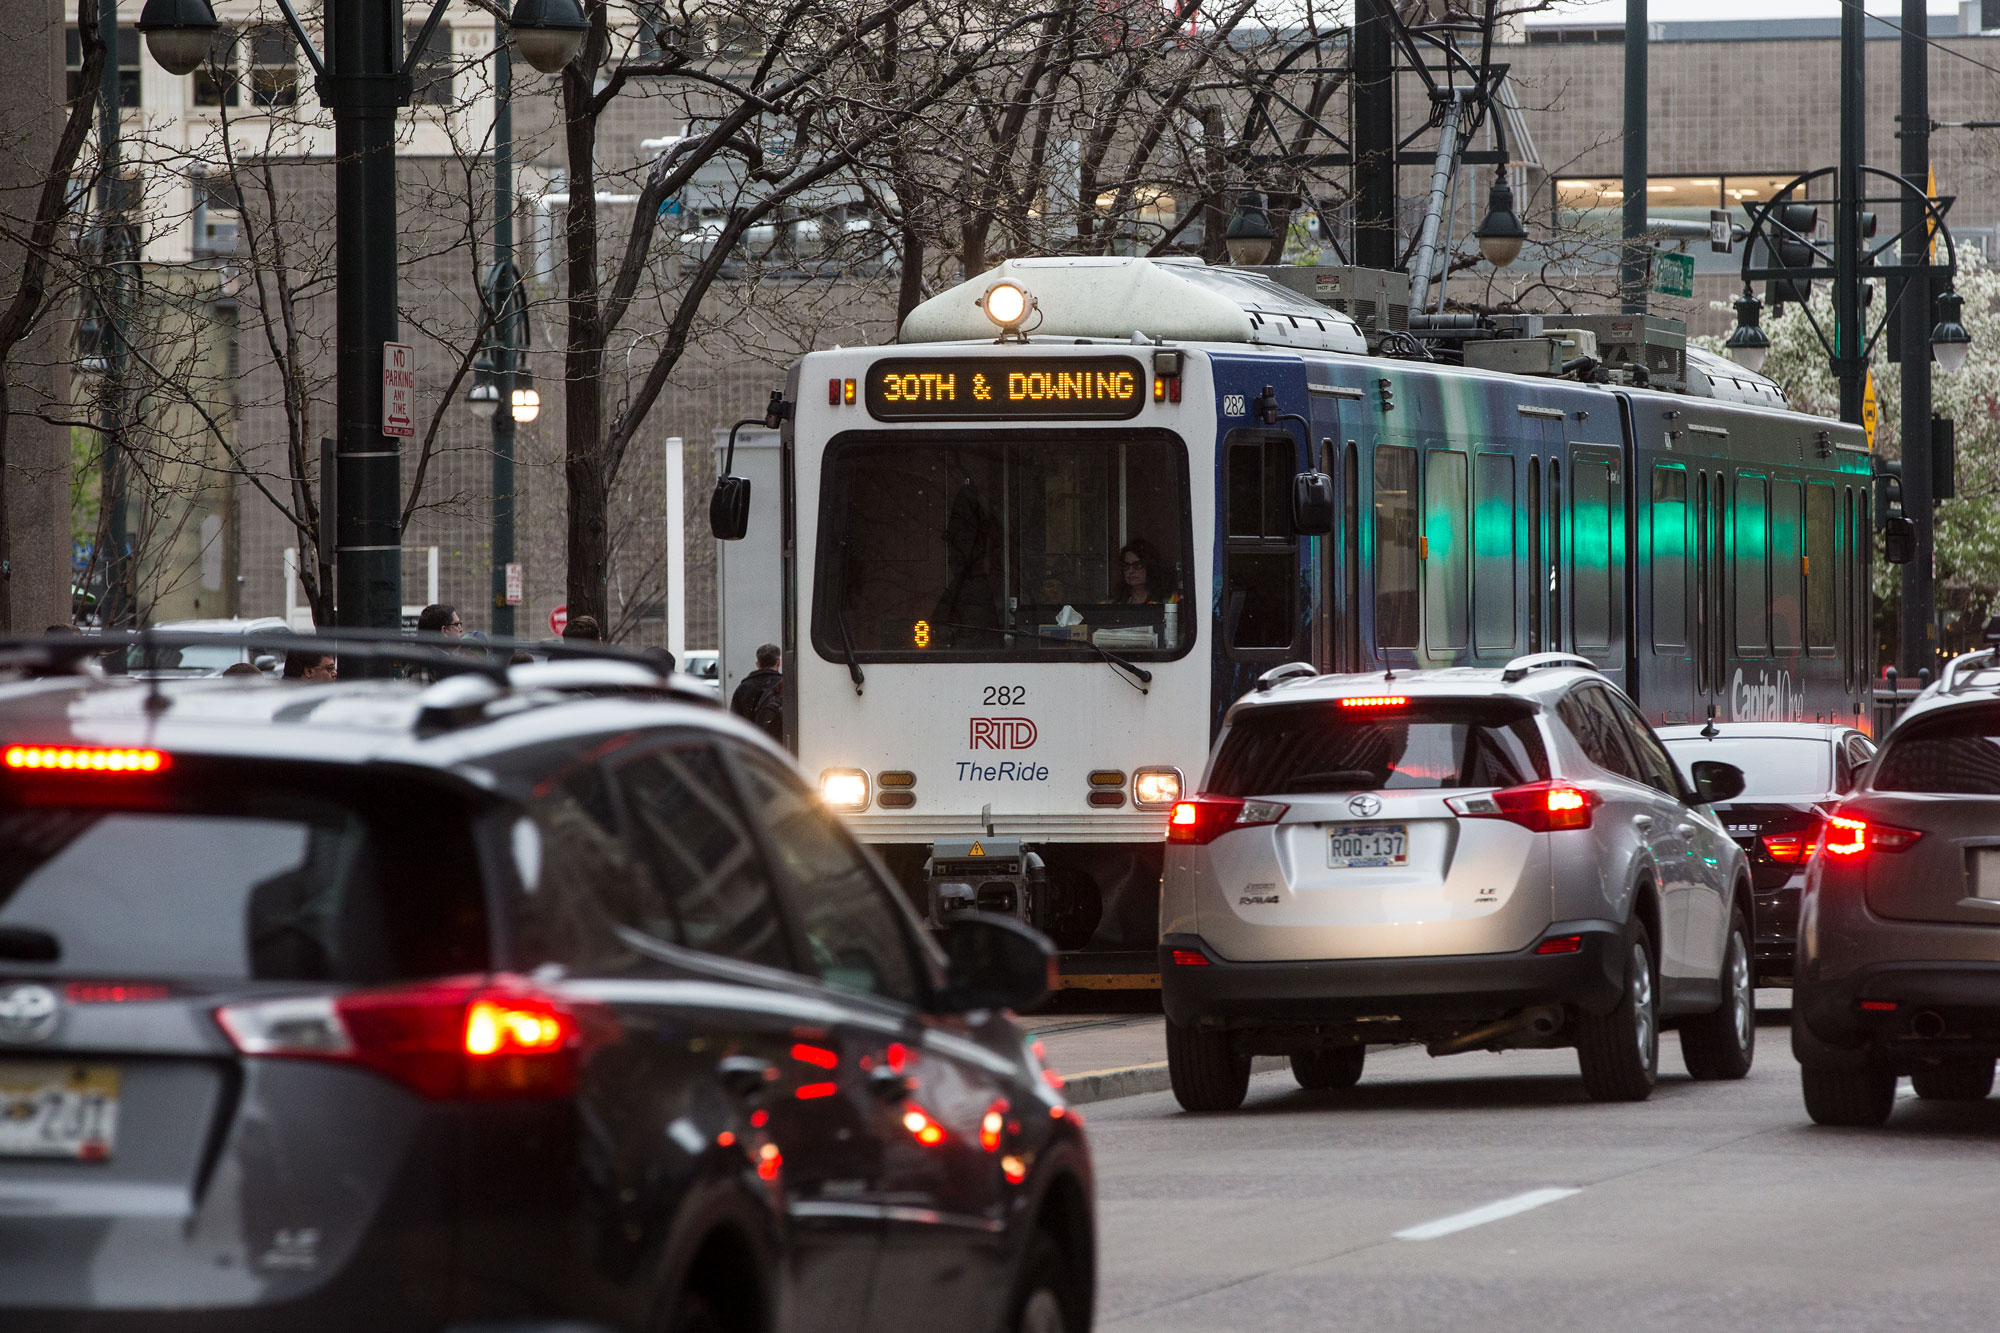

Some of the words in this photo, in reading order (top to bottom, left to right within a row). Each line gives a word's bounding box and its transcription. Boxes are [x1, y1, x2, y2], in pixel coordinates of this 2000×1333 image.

[393, 349, 406, 369] NO
[385, 369, 413, 389] PARKING
[884, 373, 955, 401] 30TH
[972, 373, 992, 401] &
[1009, 372, 1135, 400] DOWNING
[393, 389, 406, 402] ANY
[1224, 395, 1246, 416] 282
[392, 402, 407, 416] TIME
[914, 620, 930, 647] 8
[983, 685, 1026, 706] 282
[969, 717, 1038, 750] RTD
[956, 761, 1049, 781] TheRide
[1239, 895, 1280, 905] RAV4
